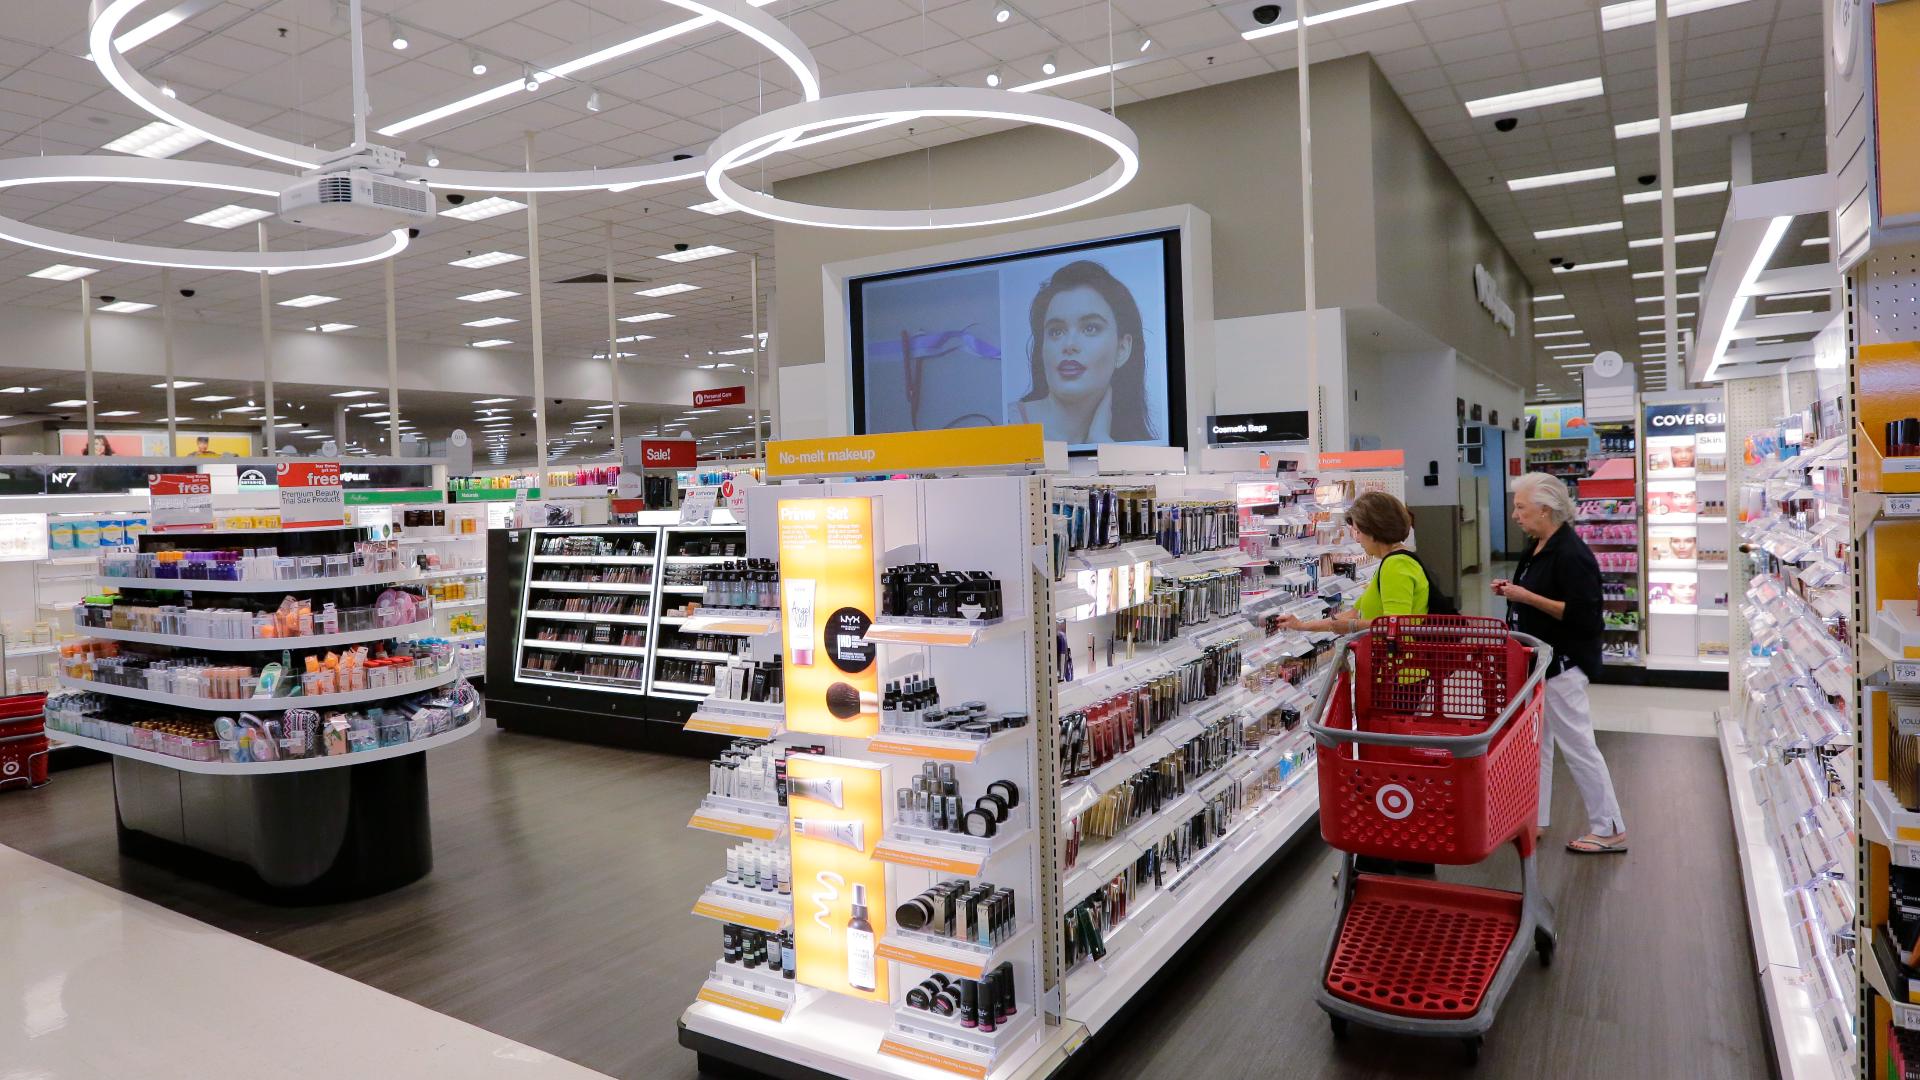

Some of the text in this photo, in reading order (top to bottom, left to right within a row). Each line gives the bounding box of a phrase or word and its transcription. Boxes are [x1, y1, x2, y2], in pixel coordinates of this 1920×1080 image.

[1212, 424, 1268, 434] Cosmetic Bags
[646, 447, 671, 460] Sale!
[779, 448, 875, 464] No-melt makeup
[307, 472, 339, 486] free
[177, 482, 209, 494] free
[282, 490, 314, 499] Premium
[315, 489, 340, 498] Beauty
[780, 507, 849, 520] Prime Set
[882, 575, 890, 584] elf
[913, 586, 924, 597] elf
[937, 587, 948, 598] elf
[966, 593, 976, 602] elf
[913, 600, 924, 612] elf
[937, 601, 948, 613] elf
[840, 615, 860, 626] NYX
